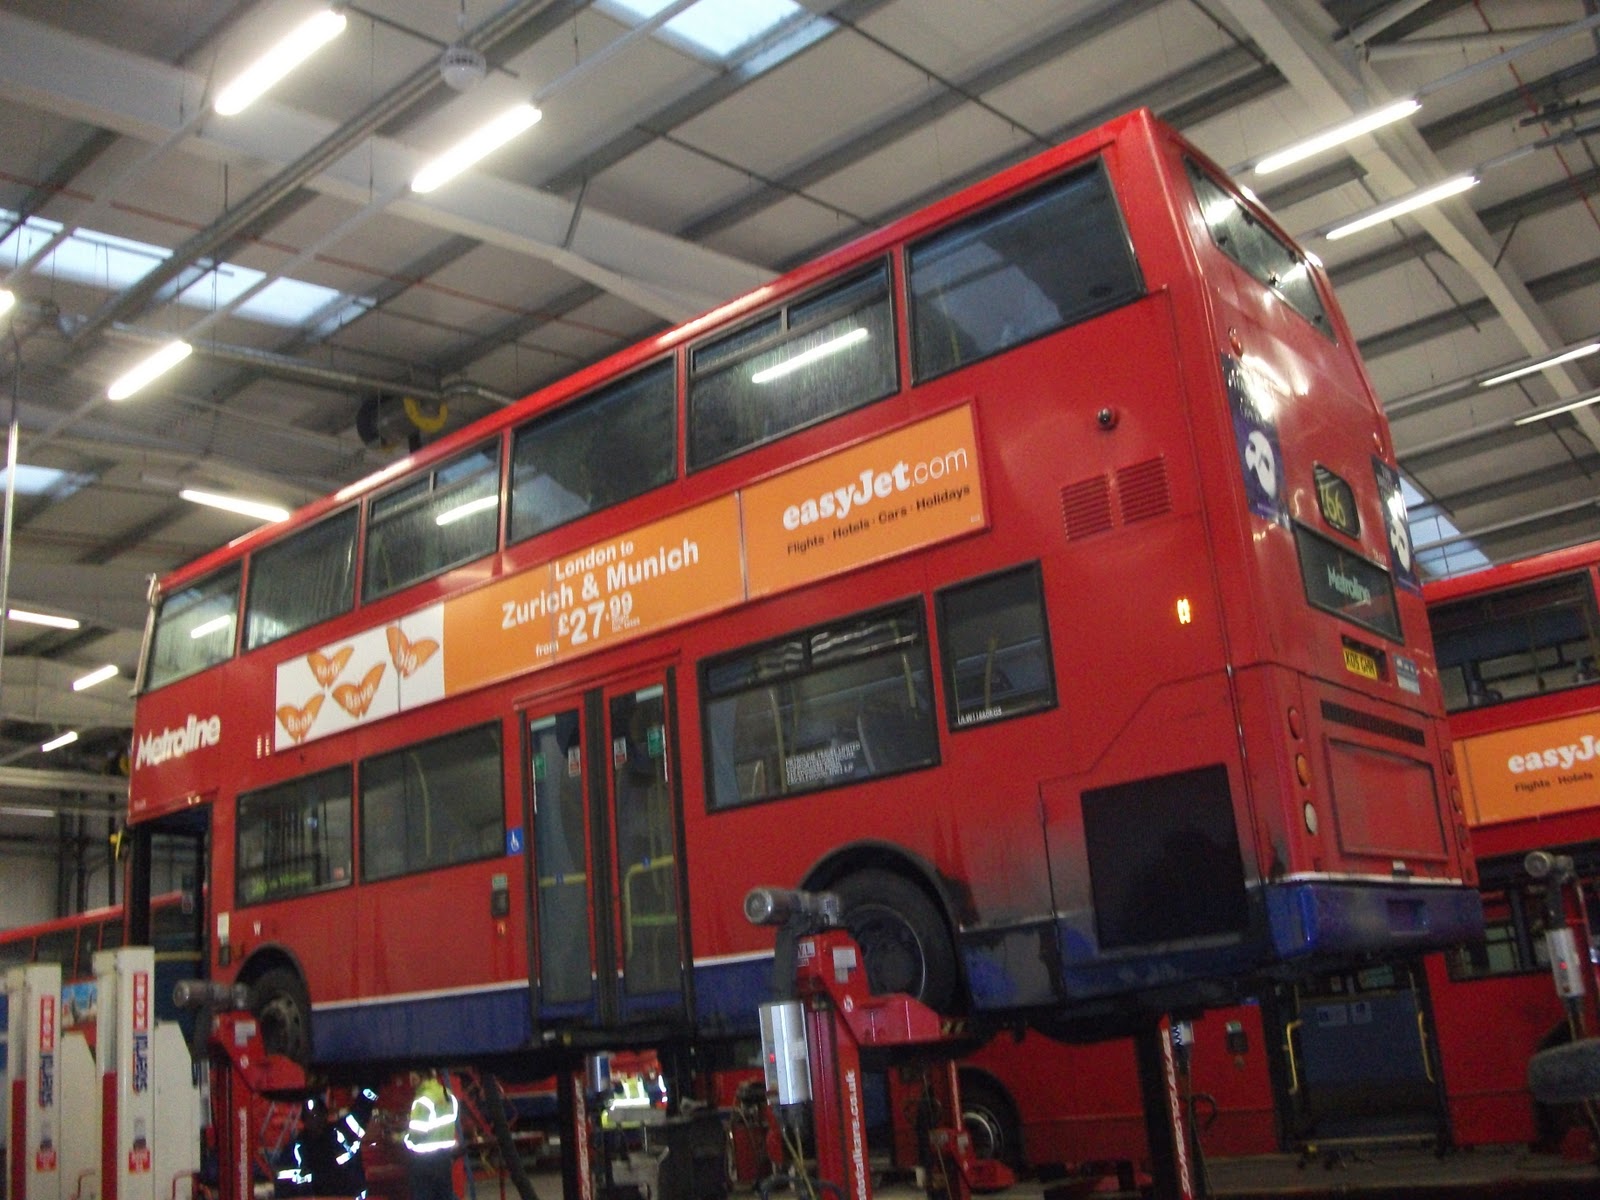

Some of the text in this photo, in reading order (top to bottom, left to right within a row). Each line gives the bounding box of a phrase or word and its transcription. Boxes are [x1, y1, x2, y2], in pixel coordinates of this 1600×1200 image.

[783, 448, 967, 530] easyJet.com
[787, 484, 970, 555] Flights Hotels Cars Holidays
[502, 537, 699, 630] Zurich & Munich
[555, 541, 634, 582] London to
[535, 640, 559, 658] from
[136, 714, 221, 770] Metroline
